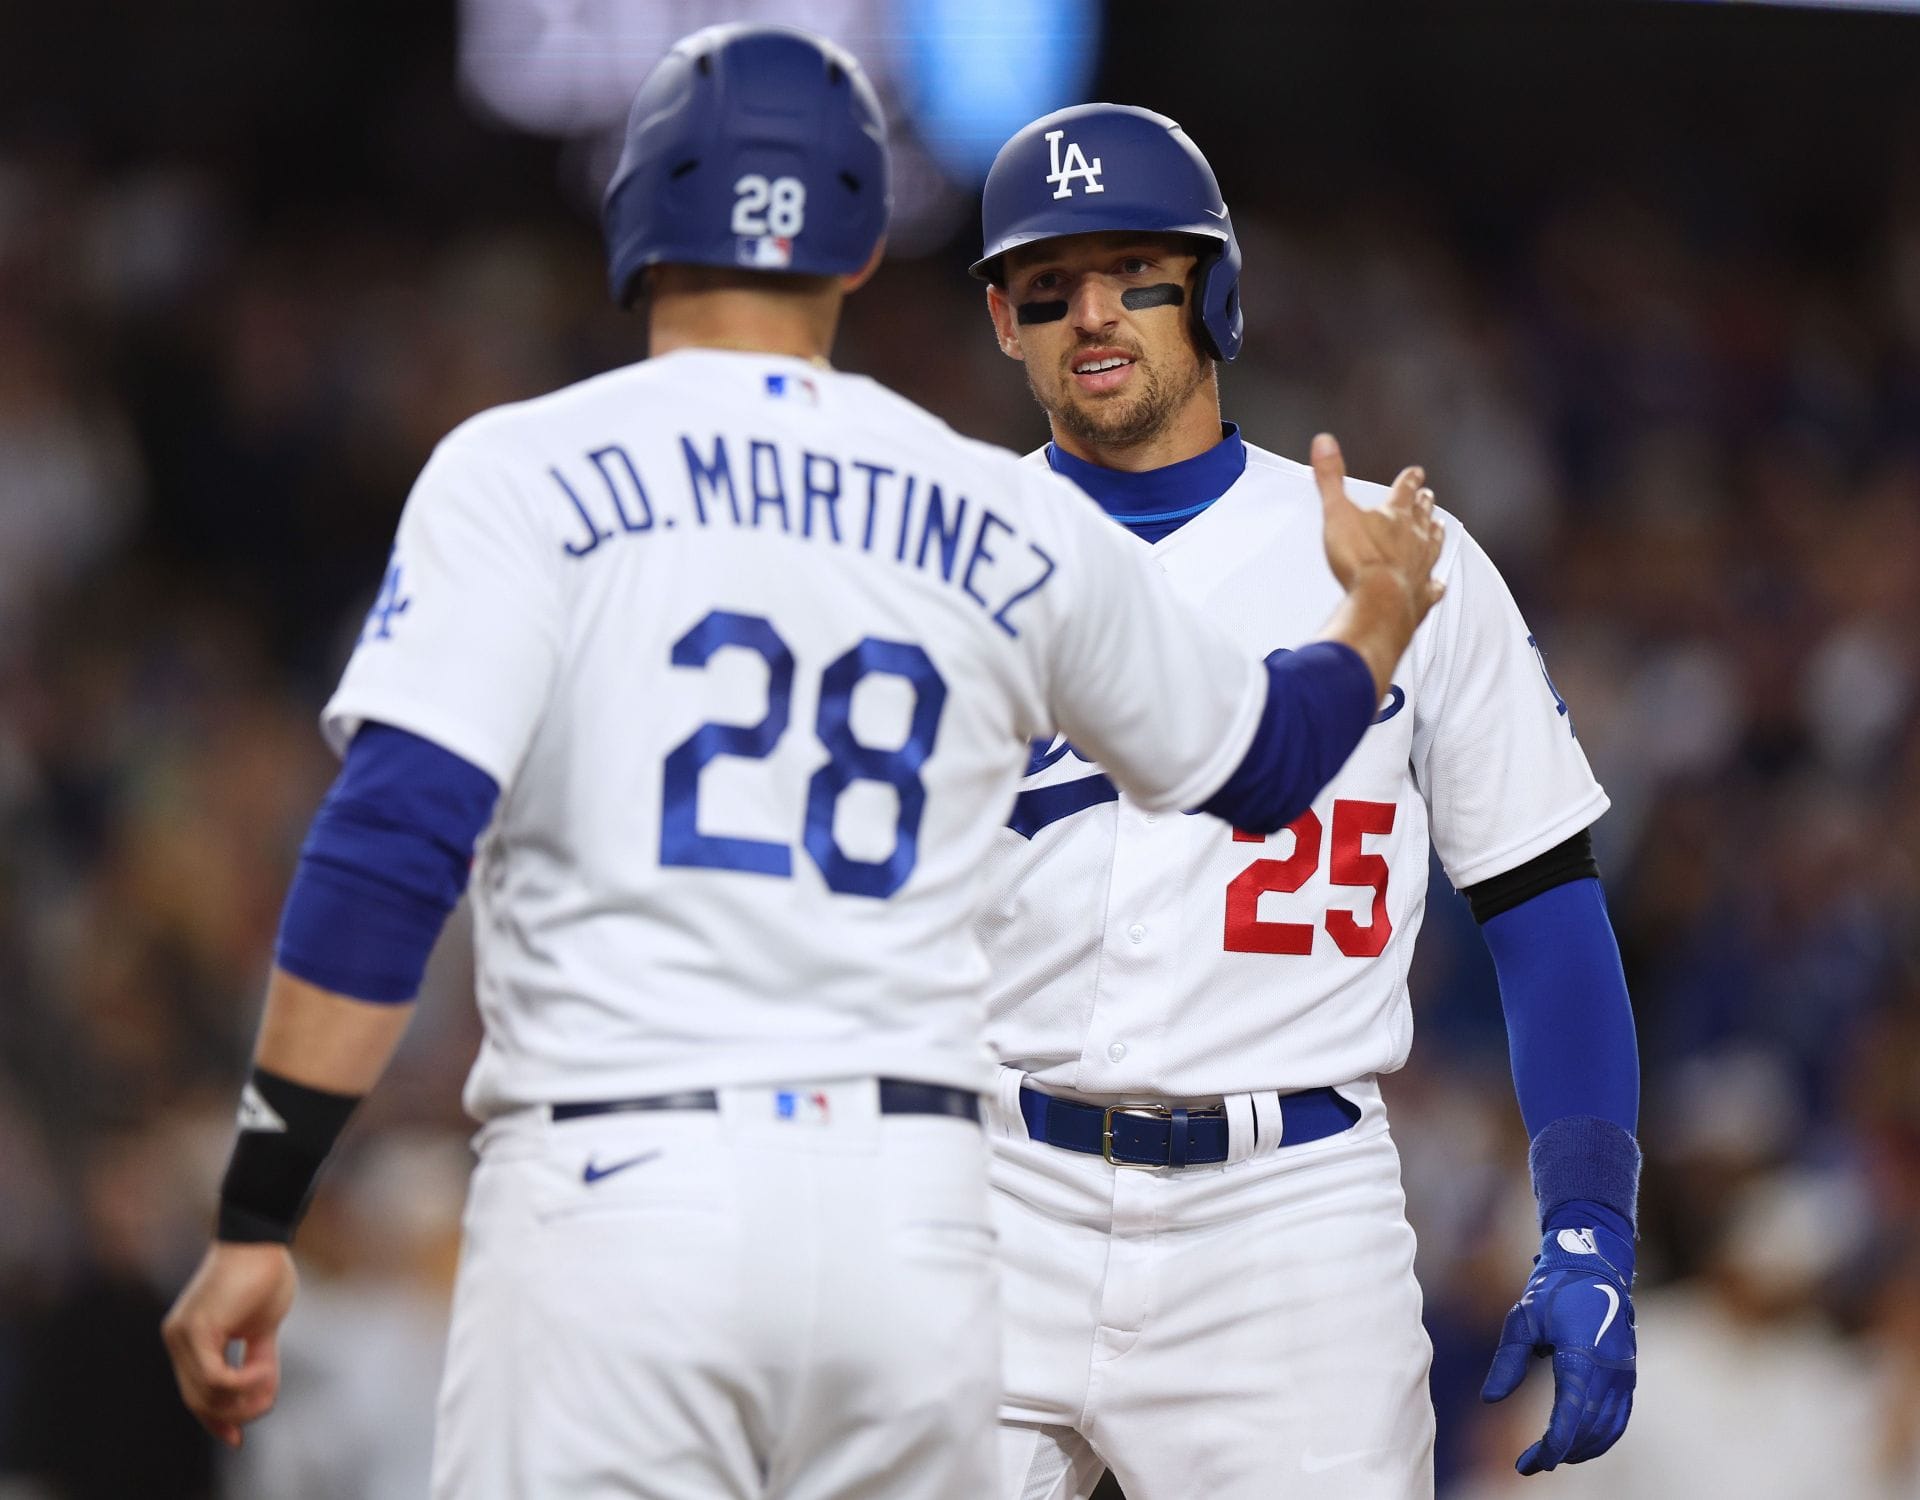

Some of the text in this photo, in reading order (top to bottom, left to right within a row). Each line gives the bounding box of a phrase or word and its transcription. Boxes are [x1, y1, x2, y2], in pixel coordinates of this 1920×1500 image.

[731, 174, 806, 238] 28
[1044, 130, 1104, 200] LA
[548, 435, 1056, 638] J.D. MARTINEZ
[659, 609, 948, 900] 28
[1224, 799, 1397, 957] 25
